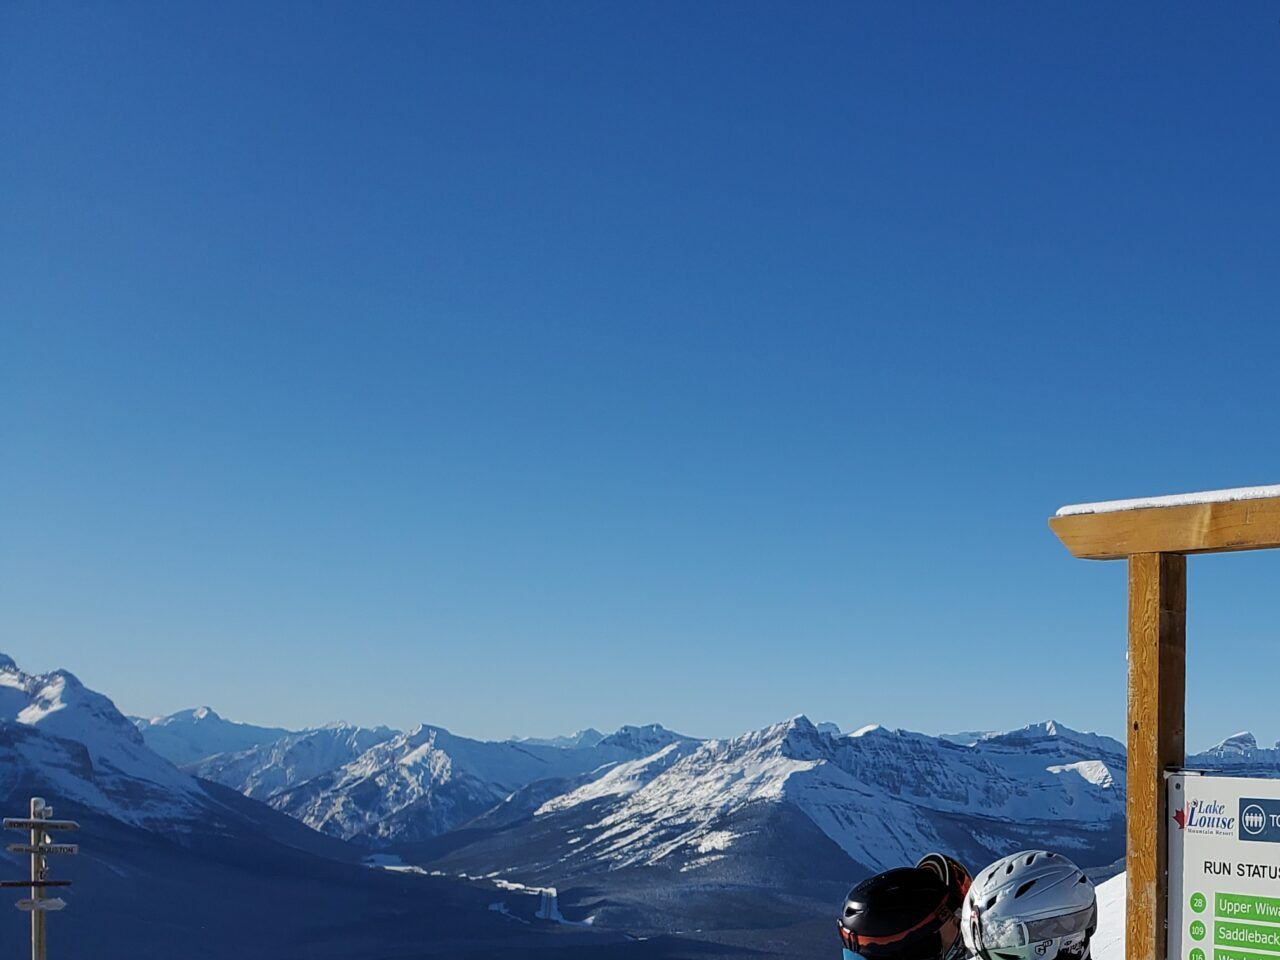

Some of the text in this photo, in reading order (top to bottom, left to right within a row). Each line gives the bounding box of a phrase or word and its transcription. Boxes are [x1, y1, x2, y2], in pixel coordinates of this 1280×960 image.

[1198, 800, 1225, 816] Lake
[1187, 808, 1235, 830] Louise
[1204, 861, 1231, 876] RUN
[1193, 899, 1203, 908] 28
[1219, 899, 1252, 917] Upper
[1191, 926, 1204, 936] 109
[1218, 927, 1280, 946] Saddleback
